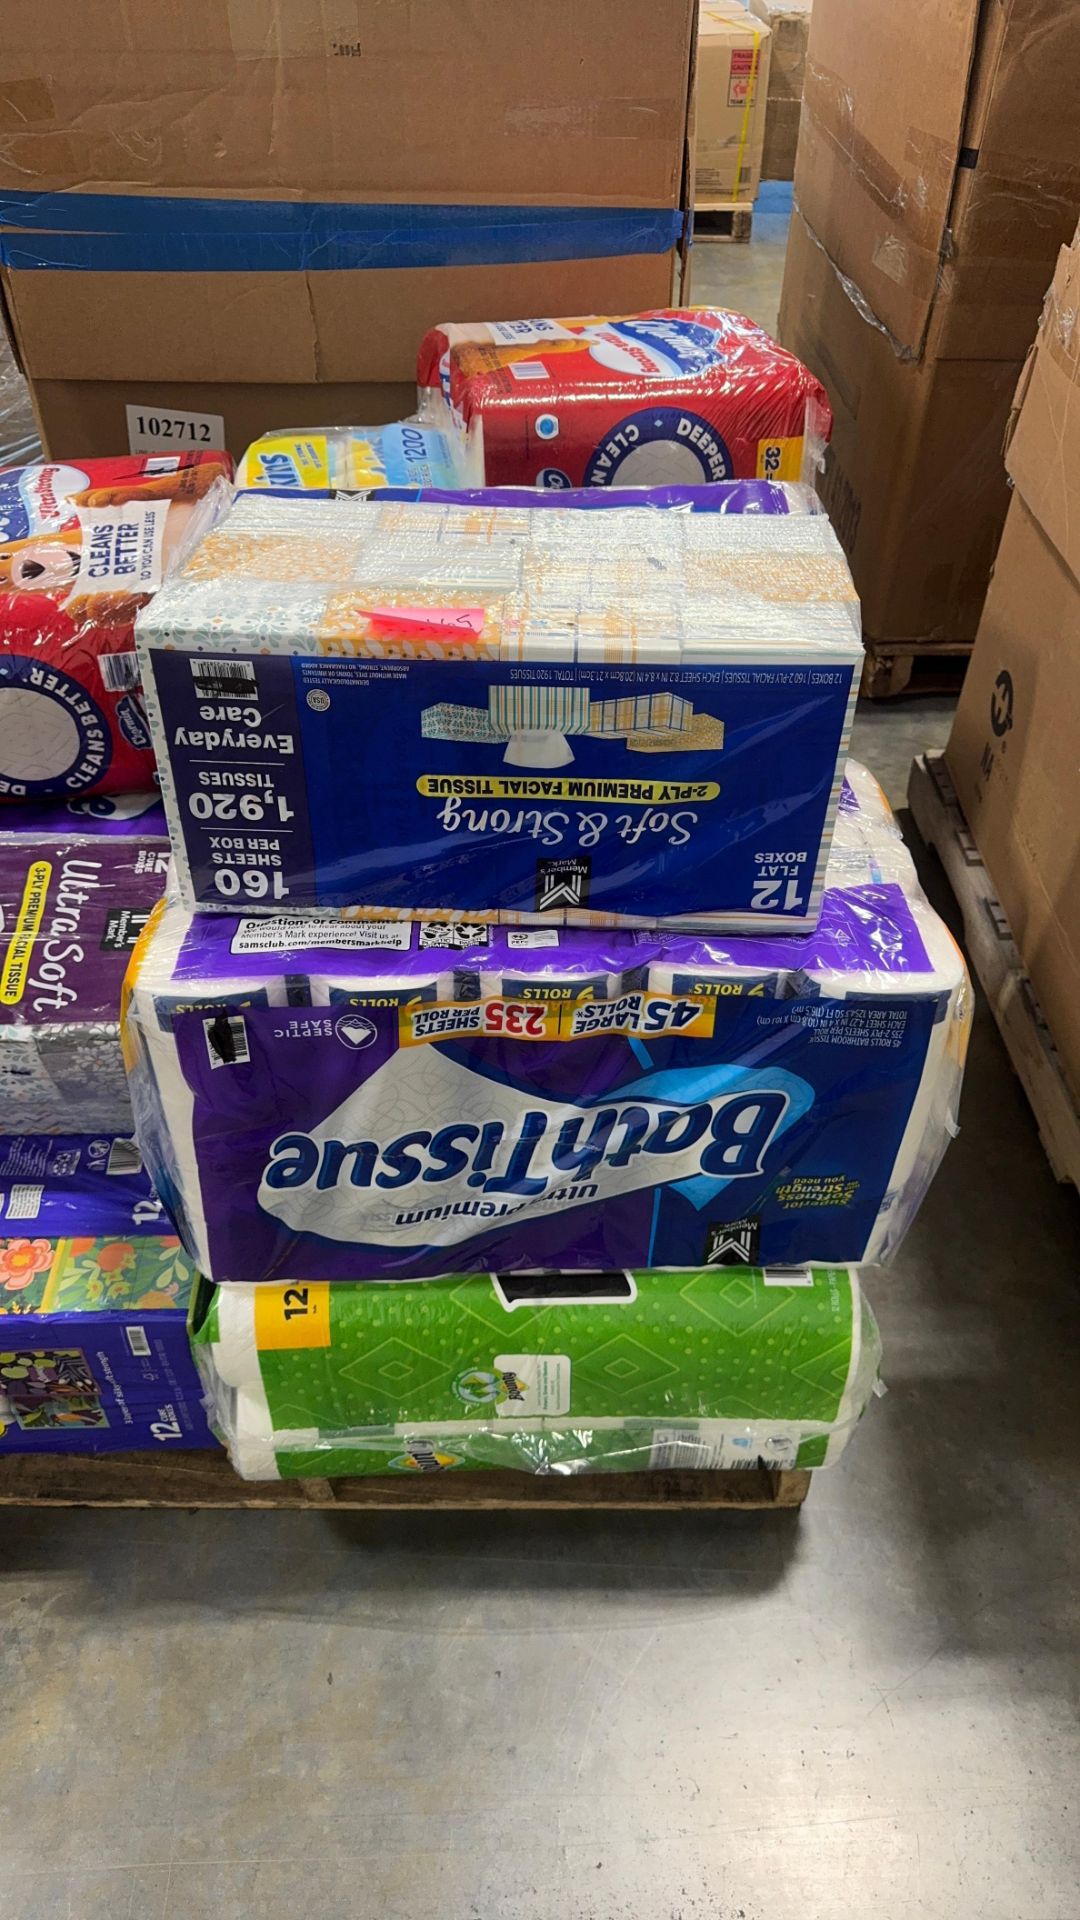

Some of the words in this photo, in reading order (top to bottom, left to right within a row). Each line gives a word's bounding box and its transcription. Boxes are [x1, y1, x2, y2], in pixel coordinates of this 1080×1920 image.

[136, 416, 211, 442] 102712
[401, 428, 427, 462] 1200
[676, 417, 727, 482] DEEPER
[589, 424, 640, 487] CLEAN
[764, 446, 780, 472] 32
[88, 524, 114, 578] CLEANS
[114, 523, 139, 576] BETTER
[510, 669, 536, 680] TISSUES
[537, 669, 552, 680] 1920
[553, 669, 574, 681] TOTAL
[680, 671, 701, 683] SHEET
[702, 671, 720, 683] EACH
[724, 672, 751, 683] TISSUES
[752, 672, 775, 683] FACIAL
[794, 672, 807, 684] 160
[811, 672, 833, 684] BOXES
[834, 673, 843, 683] 12
[200, 705, 262, 727] Care
[174, 727, 295, 754] Everyday
[66, 729, 105, 788] CLEANS
[199, 771, 275, 788] TISSUES
[427, 778, 493, 794] TISSUE
[499, 780, 563, 796] FACIAL
[568, 780, 653, 800] PREMIUM
[660, 784, 708, 800] 2-PLY
[188, 790, 295, 822] 1,920
[436, 796, 570, 846] Strong
[616, 807, 698, 845] Soft
[575, 812, 608, 847] &
[209, 837, 244, 850] BOX
[248, 839, 280, 851] PER
[212, 852, 282, 866] SHEETS
[551, 859, 577, 867] Mark
[754, 852, 808, 863] BOXES
[540, 866, 588, 874] Member's
[757, 866, 799, 877] FLAT
[214, 868, 290, 900] 160
[51, 860, 103, 937] Ultra
[750, 880, 804, 911] 12
[22, 892, 42, 935] PREMIUM
[105, 919, 119, 942] Mark
[113, 910, 131, 949] Member's
[284, 930, 307, 939] Mark
[359, 931, 378, 939] Visit
[4, 962, 24, 998] TISSUE
[28, 939, 85, 1012] Soft
[415, 1009, 452, 1022] ROLL
[452, 1008, 480, 1019] PER
[485, 1001, 546, 1035] 235
[644, 1000, 701, 1032] 45
[790, 1015, 801, 1023] cm
[825, 1009, 834, 1018] FT
[835, 1009, 844, 1018] SQ
[868, 1010, 886, 1019] AREA
[887, 1010, 907, 1019] TOTAL
[290, 1020, 332, 1029] SAFE
[414, 1016, 480, 1037] SHEETS
[572, 1012, 641, 1034] LARGE
[757, 1016, 770, 1026] cm)
[802, 1016, 819, 1027] (10.8
[865, 1020, 886, 1029] SHEET
[886, 1020, 906, 1029] EACH
[274, 1028, 332, 1038] SEPTIC
[830, 1028, 843, 1036] PER
[844, 1028, 870, 1037] SHEETS
[870, 1029, 890, 1038] 2-PLY
[891, 1030, 904, 1039] 235
[831, 1036, 870, 1047] BATHROOM
[870, 1038, 892, 1047] ROLLS
[892, 1040, 902, 1048] 45
[551, 1092, 790, 1182] Bath
[266, 1111, 549, 1195] Tissue
[793, 1176, 821, 1185] need
[824, 1175, 845, 1184] you
[543, 1184, 598, 1203] Ultr
[775, 1183, 844, 1194] Strength
[777, 1190, 854, 1202] Softness
[783, 1199, 850, 1210] Superior
[395, 1200, 525, 1225] Premium
[711, 1222, 758, 1236] Member's
[284, 1288, 309, 1321] 12
[502, 1371, 525, 1402] Bounty
[163, 1404, 177, 1422] BOXES
[150, 1420, 183, 1441] 12
